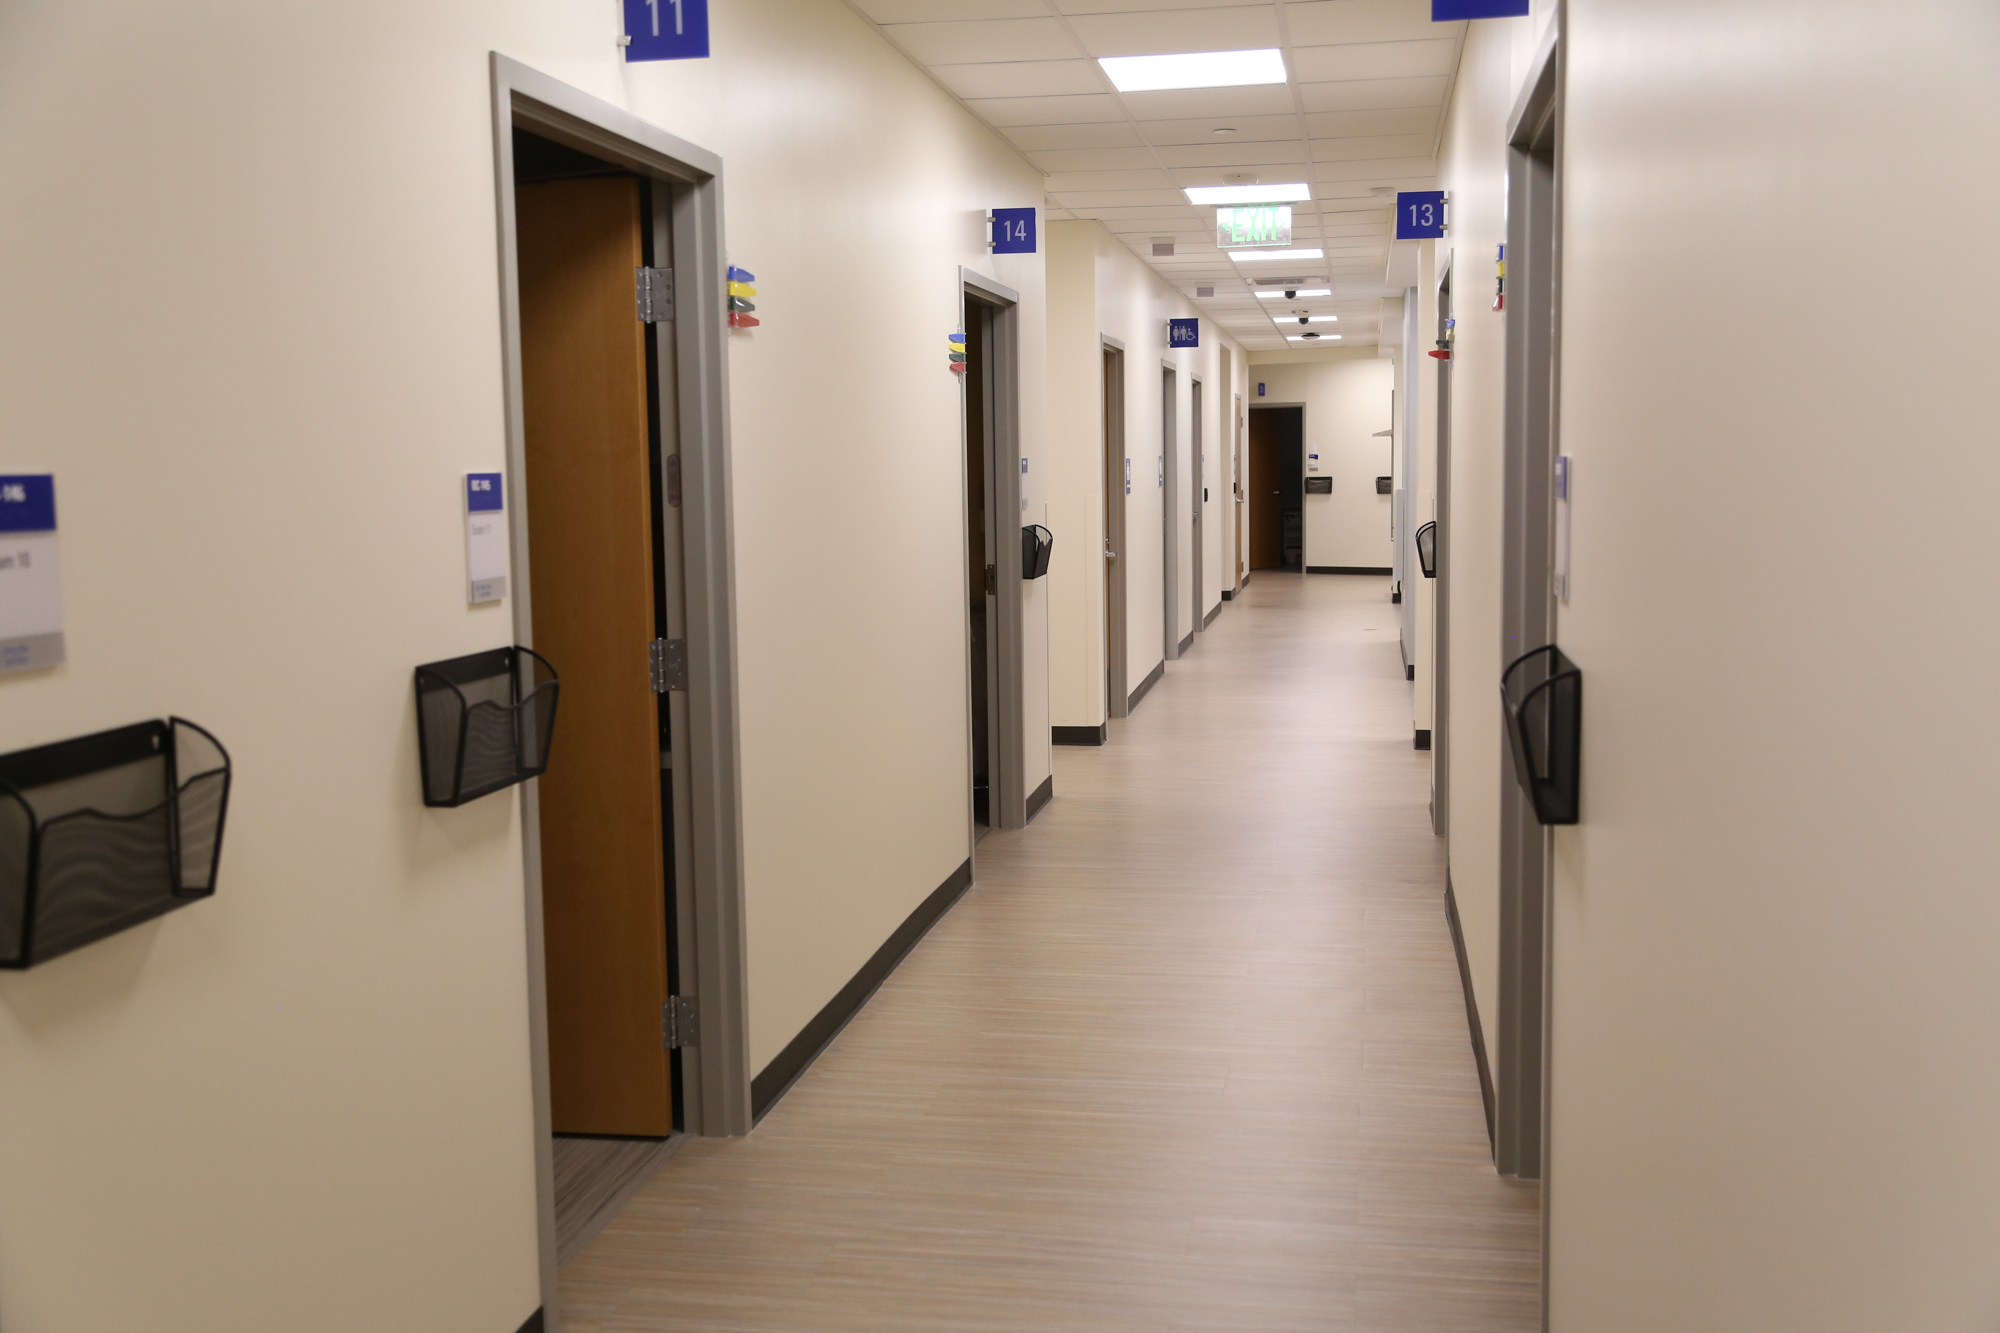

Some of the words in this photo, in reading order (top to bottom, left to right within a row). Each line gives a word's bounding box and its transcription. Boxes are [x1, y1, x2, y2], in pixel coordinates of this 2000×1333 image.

[645, 0, 683, 36] 11
[1231, 207, 1280, 242] EXIT
[1409, 203, 1434, 227] 13
[1003, 220, 1027, 242] 14
